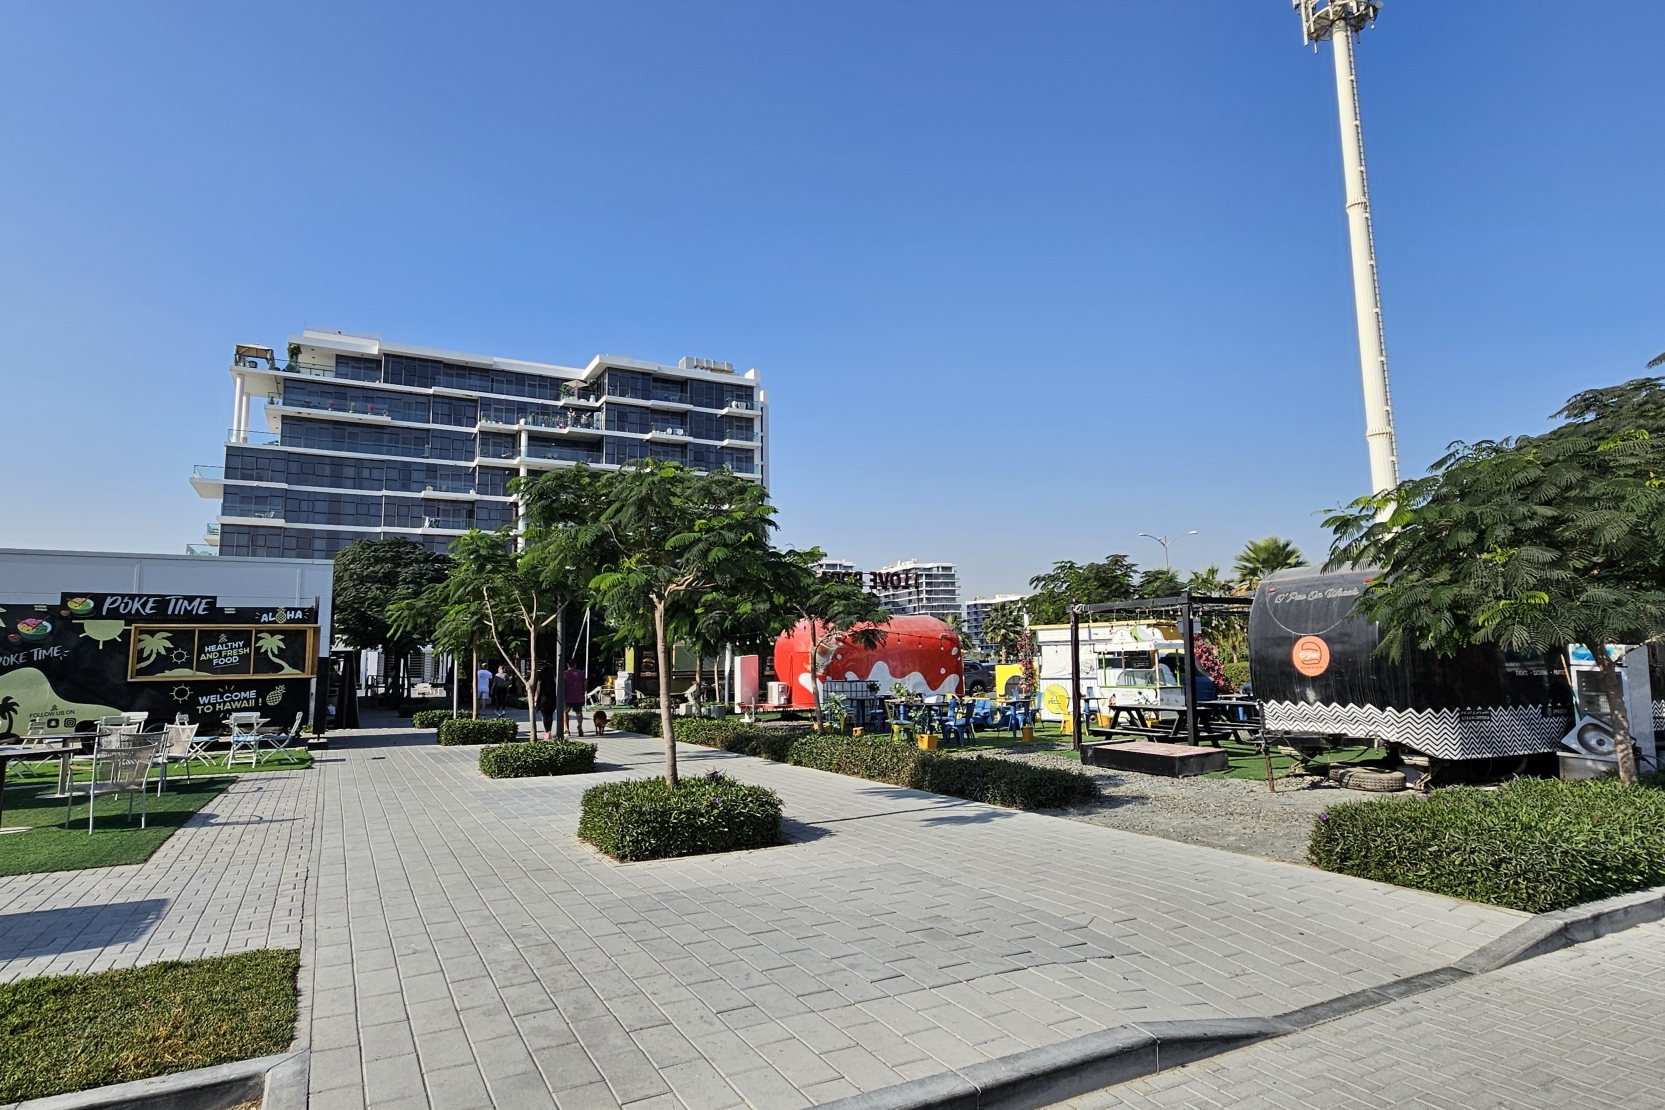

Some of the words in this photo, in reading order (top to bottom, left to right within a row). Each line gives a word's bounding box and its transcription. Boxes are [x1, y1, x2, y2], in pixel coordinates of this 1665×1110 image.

[102, 595, 163, 616] POKE
[164, 595, 215, 616] TIME
[30, 645, 63, 661] TIME
[199, 652, 219, 661] AND
[221, 647, 250, 658] FRESH
[204, 641, 244, 653] HEALTHY
[212, 656, 239, 666] FOOD
[198, 690, 257, 704] WELCOME
[196, 705, 213, 714] TO
[215, 699, 255, 711] HAWAII
